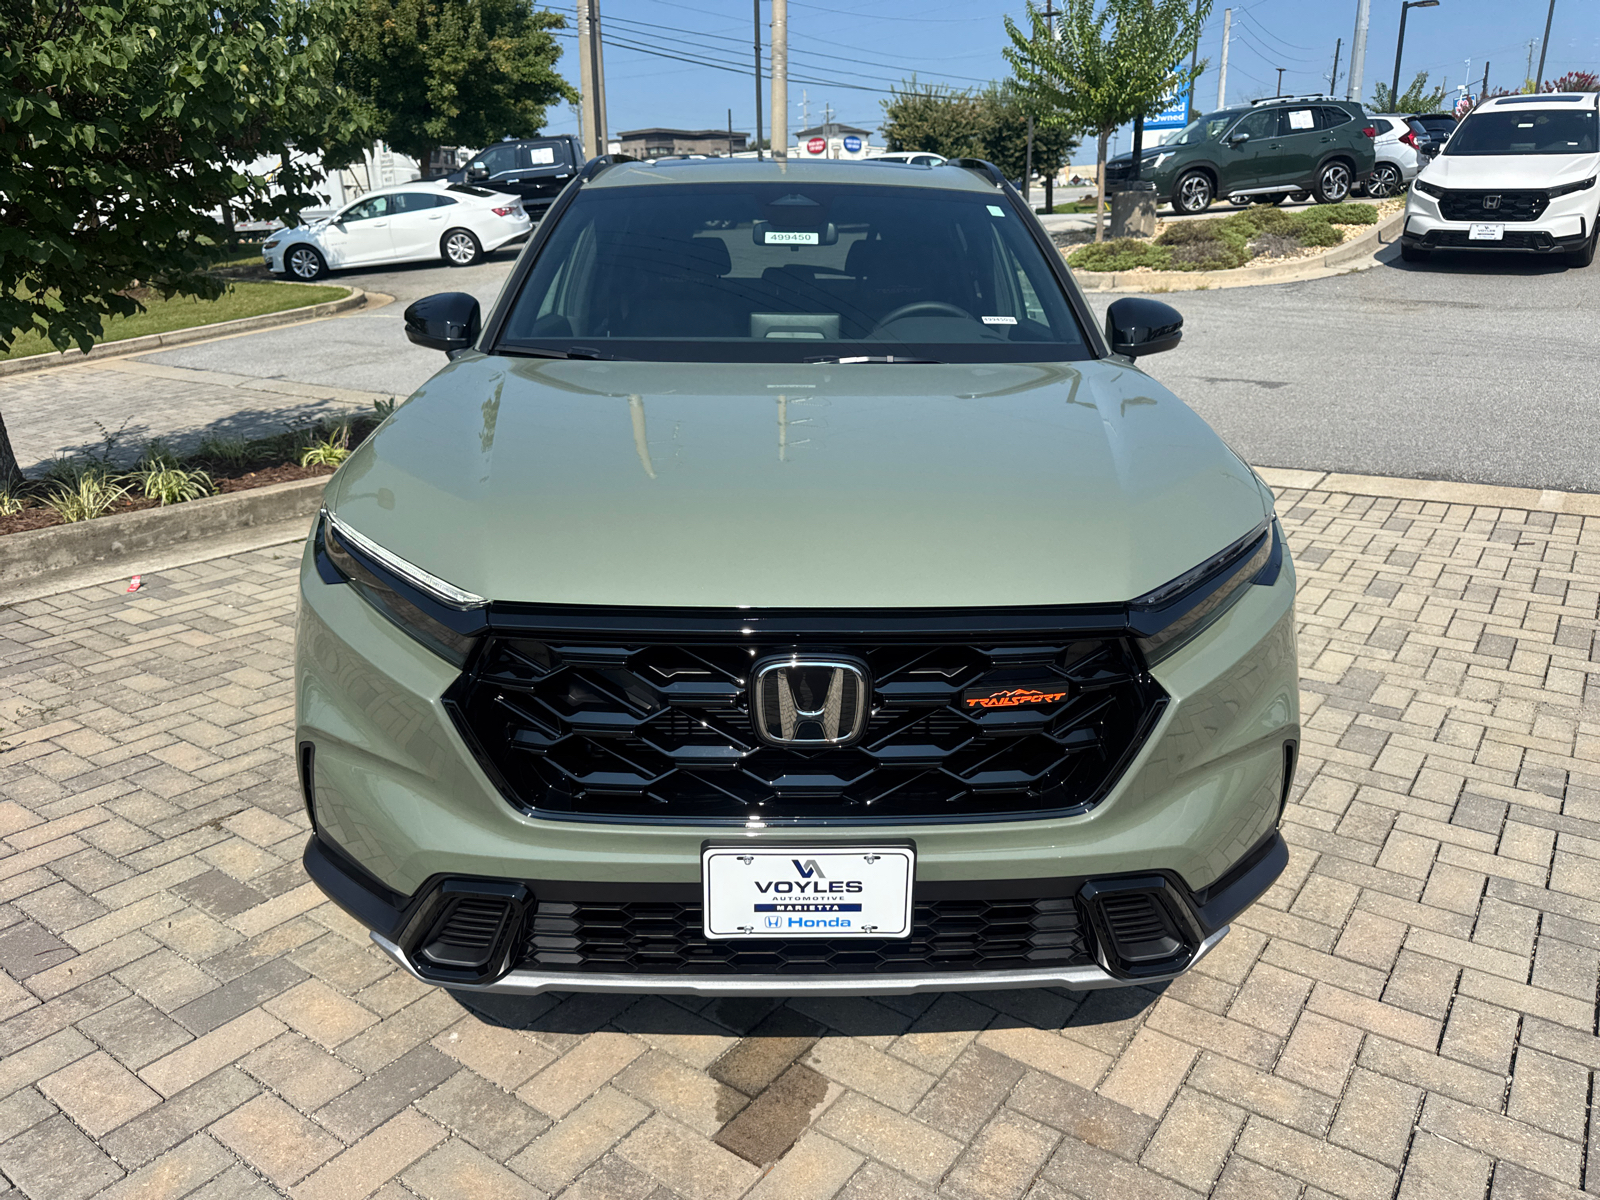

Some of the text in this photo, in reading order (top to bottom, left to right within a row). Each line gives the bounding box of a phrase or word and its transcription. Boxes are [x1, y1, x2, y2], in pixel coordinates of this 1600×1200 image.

[966, 692, 1067, 708] TRAILSPORT
[754, 881, 863, 893] VOYLES
[788, 917, 851, 928] Honda
